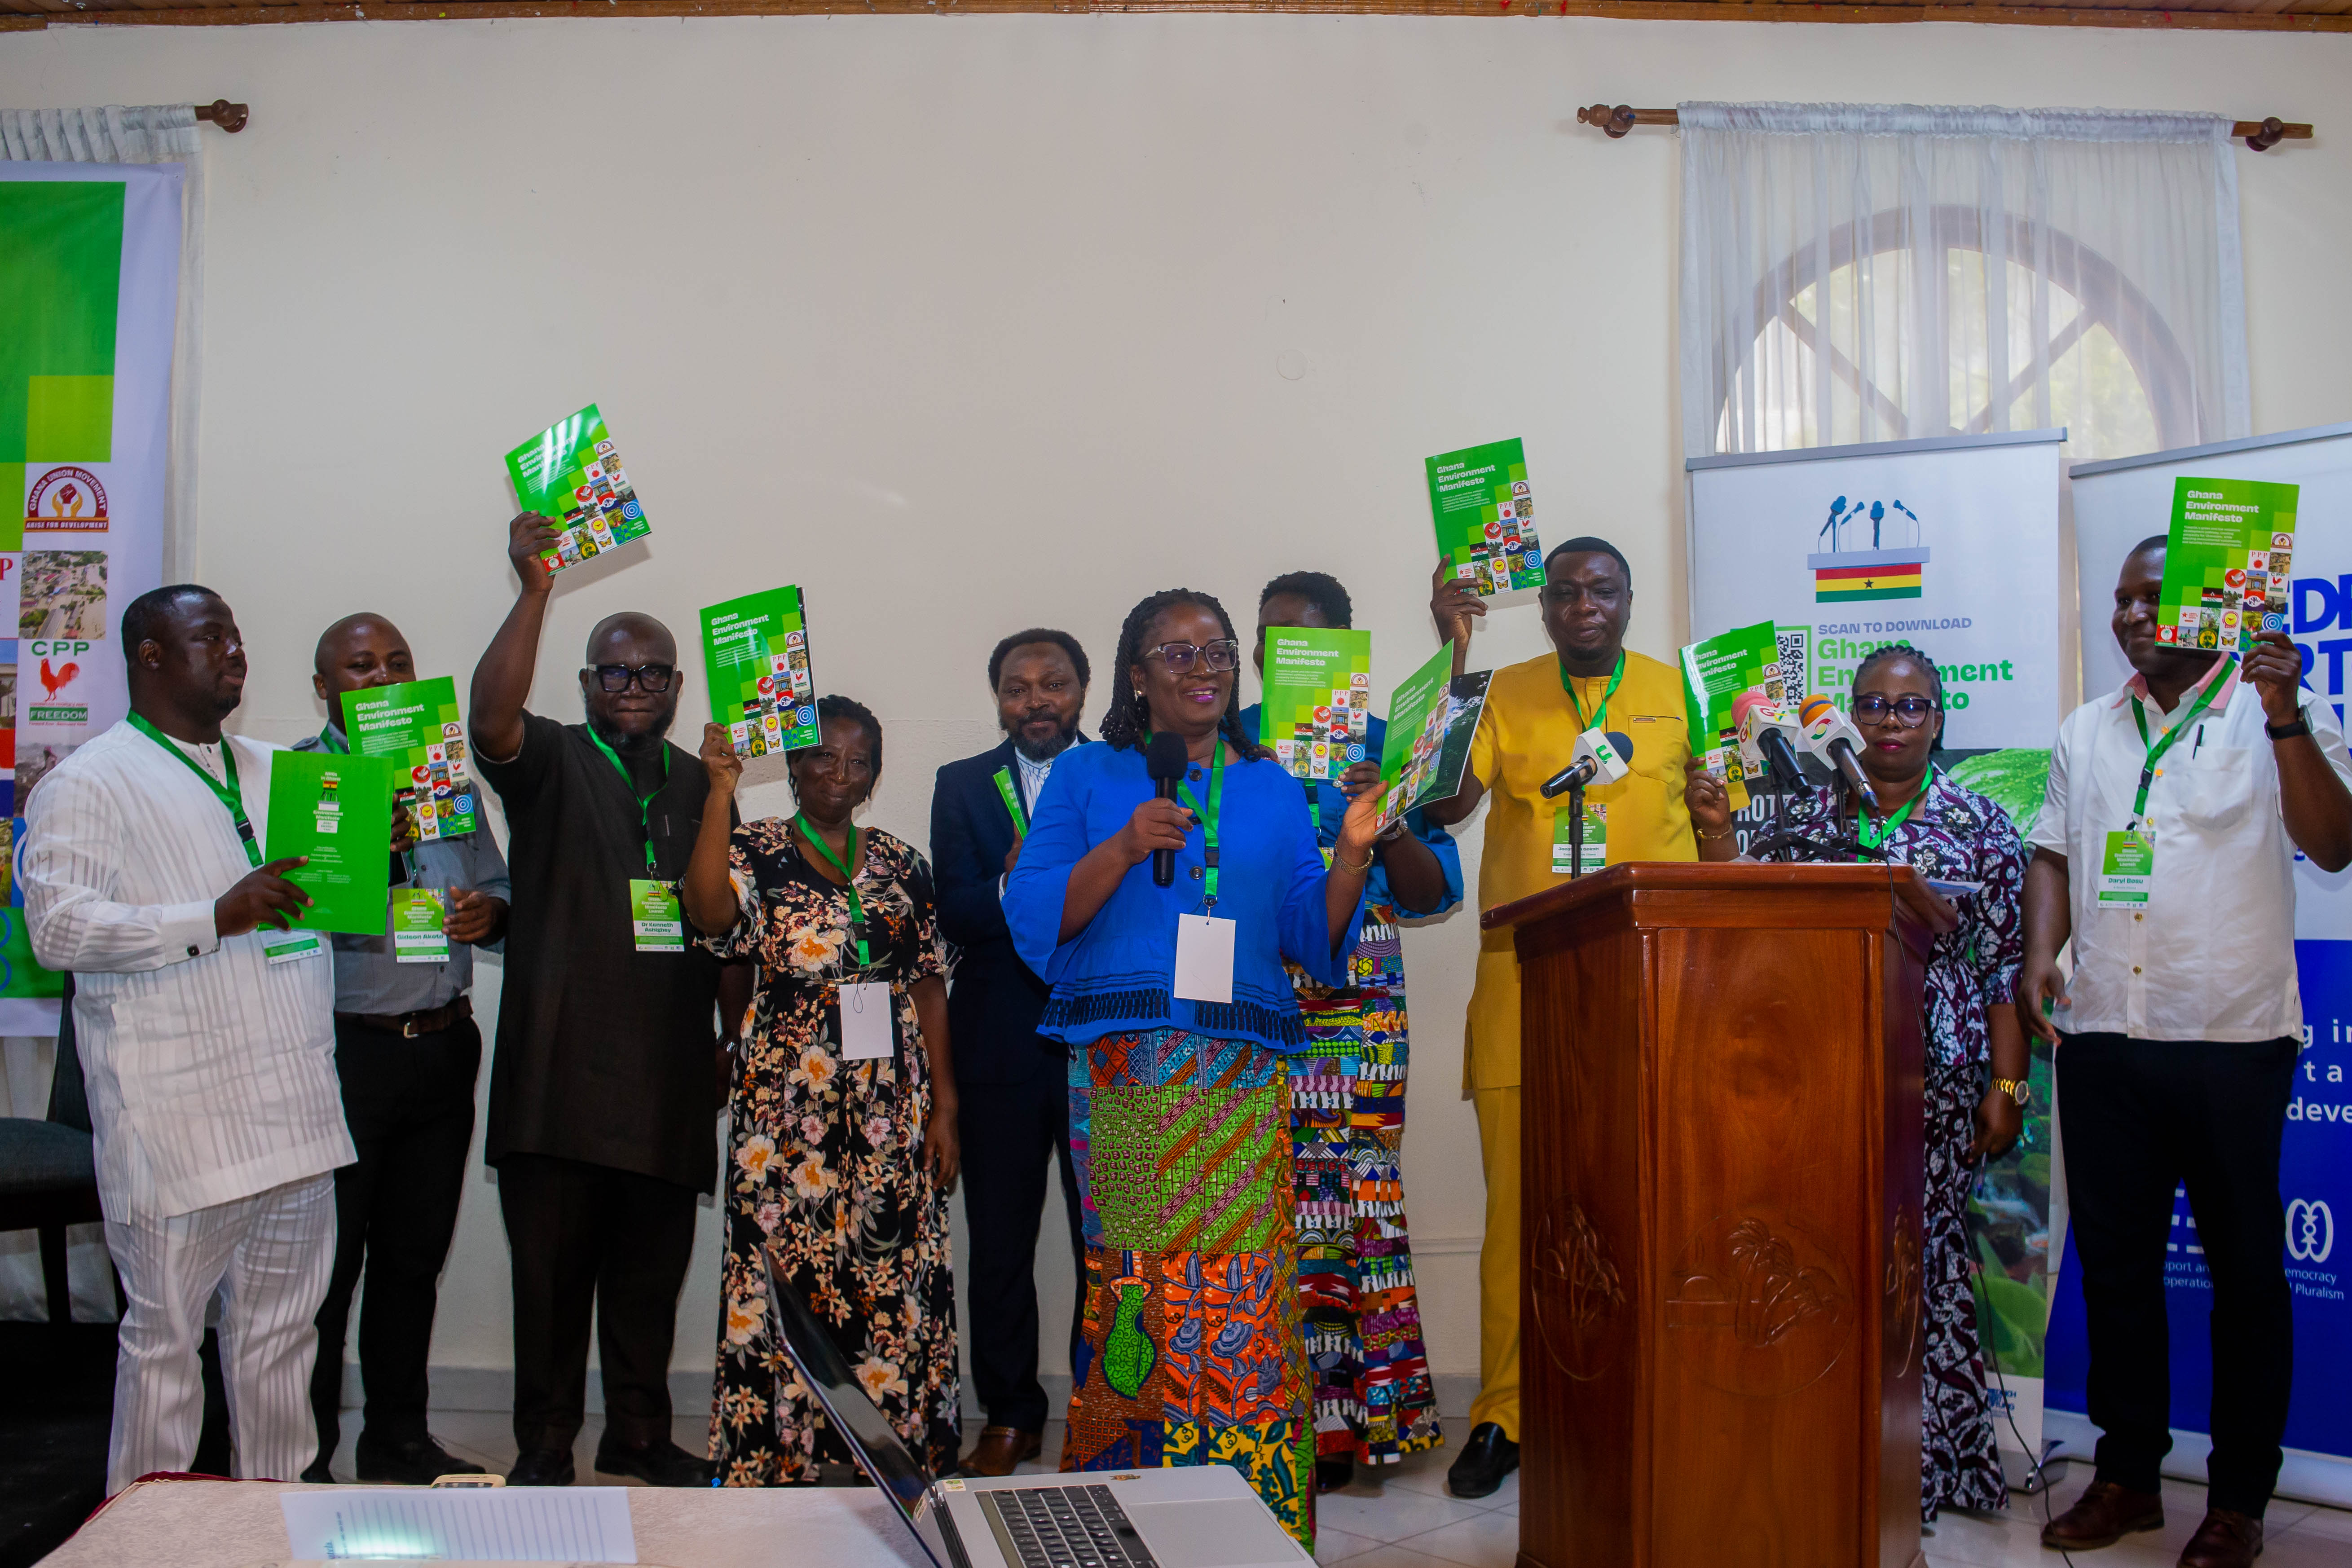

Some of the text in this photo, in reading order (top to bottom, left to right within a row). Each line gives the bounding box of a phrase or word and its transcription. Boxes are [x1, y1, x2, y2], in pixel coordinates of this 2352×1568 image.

[1437, 462, 1465, 474] Ghana
[1438, 464, 1496, 483] Environment
[29, 469, 106, 511] GHANA UNION MOVEMENT
[1440, 477, 1485, 492] Manifesto
[2187, 490, 2223, 500] Ghana
[2186, 501, 2260, 513] Environment
[2185, 512, 2243, 523] Manifesto
[544, 553, 559, 561] PNC
[711, 613, 738, 625] Ghana
[712, 614, 769, 636] Environment
[1818, 617, 1972, 635] SCAN TO DOWNLOAD
[714, 629, 758, 646] Manifesto
[31, 641, 89, 656] CPP
[1277, 648, 1339, 657] Environment
[1695, 649, 1718, 661] hana
[1276, 657, 1326, 665] Manifesto
[1696, 649, 1748, 669] nvironment
[1700, 662, 1737, 678] anifesto
[1395, 677, 1434, 713] Environment
[1396, 685, 1415, 704] Ghana
[356, 700, 389, 711] Ghana
[357, 704, 424, 722] Environment
[1393, 694, 1425, 722] Manifesto
[30, 710, 88, 720] FREEDOM
[359, 717, 412, 732] Manifesto
[2295, 1282, 2345, 1301] Pluralism
